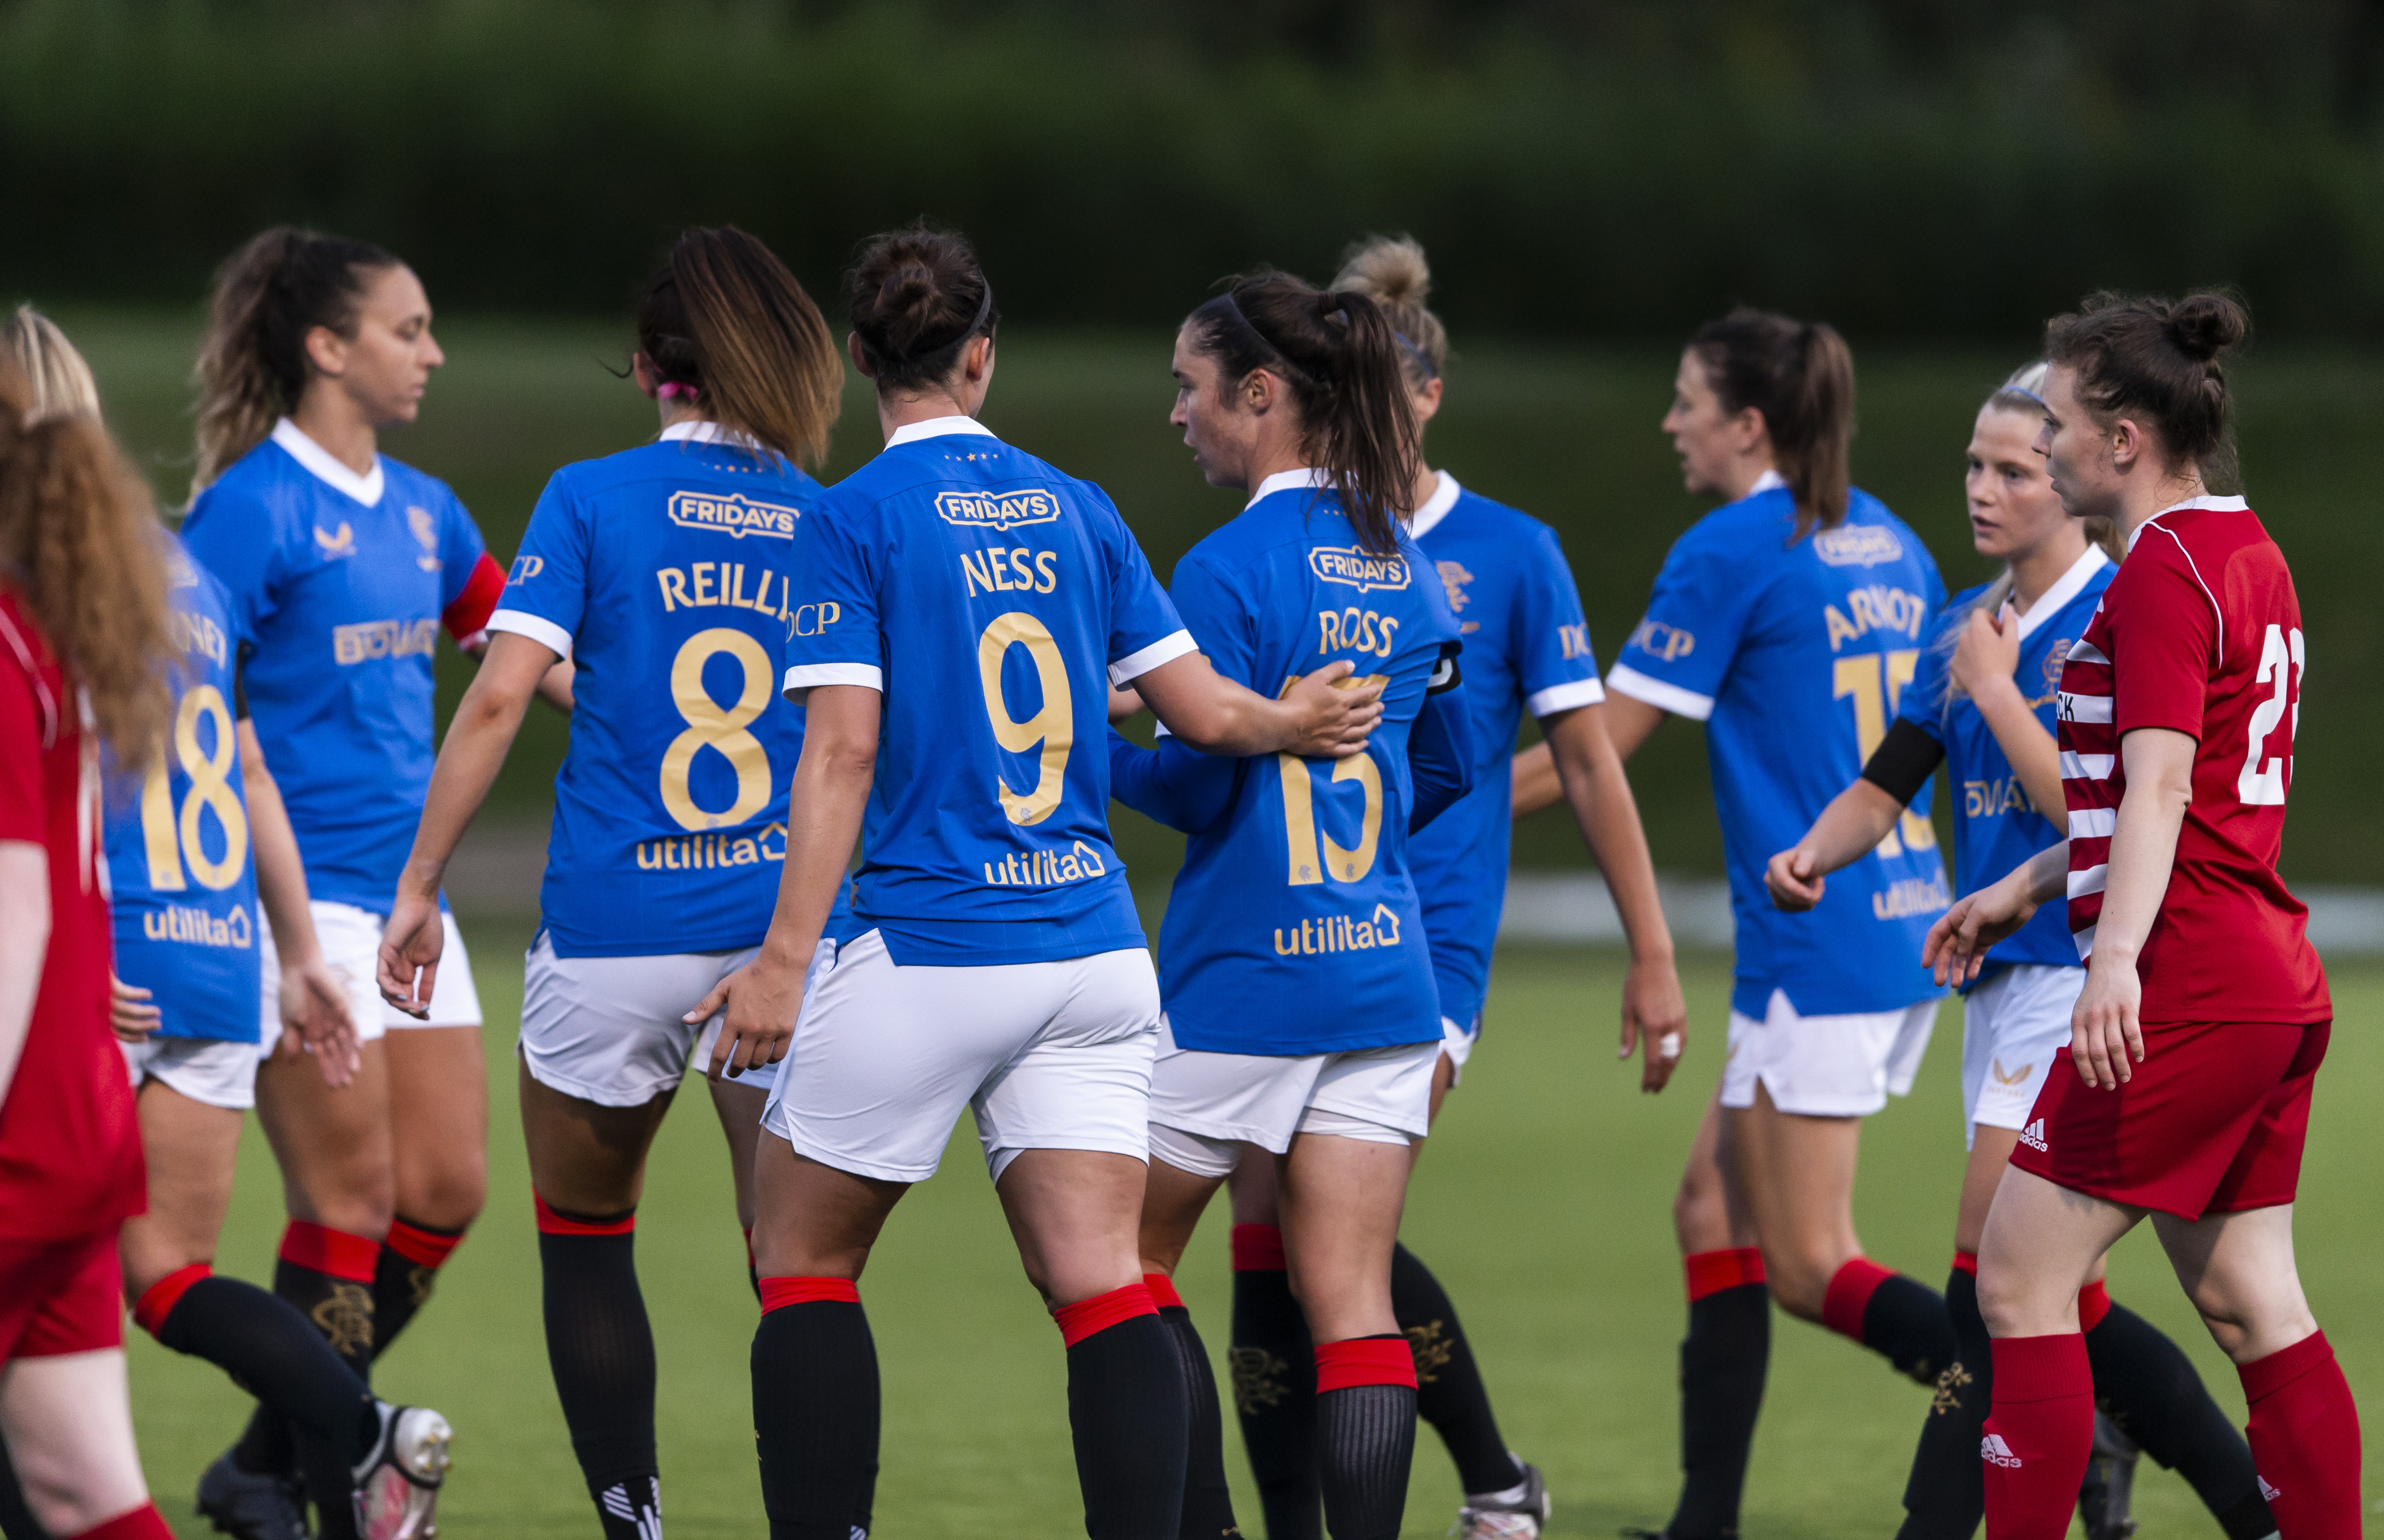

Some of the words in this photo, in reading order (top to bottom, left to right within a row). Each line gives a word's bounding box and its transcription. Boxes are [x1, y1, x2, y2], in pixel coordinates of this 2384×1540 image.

[680, 498, 794, 533] FRIDAYS
[945, 496, 1049, 520] FRIDAYS
[960, 547, 1057, 597] NESS
[1319, 554, 1403, 582] FRIDAYS
[1319, 606, 1399, 658] ROSS
[979, 612, 1073, 826] 9
[2056, 693, 2075, 722] CK
[660, 627, 774, 832] 8
[141, 684, 248, 891] 18
[637, 834, 760, 870] utilita
[984, 849, 1085, 885] utilita
[143, 906, 230, 947] utilita
[1274, 914, 1376, 956] utilita
[2019, 1133, 2048, 1152] adidas
